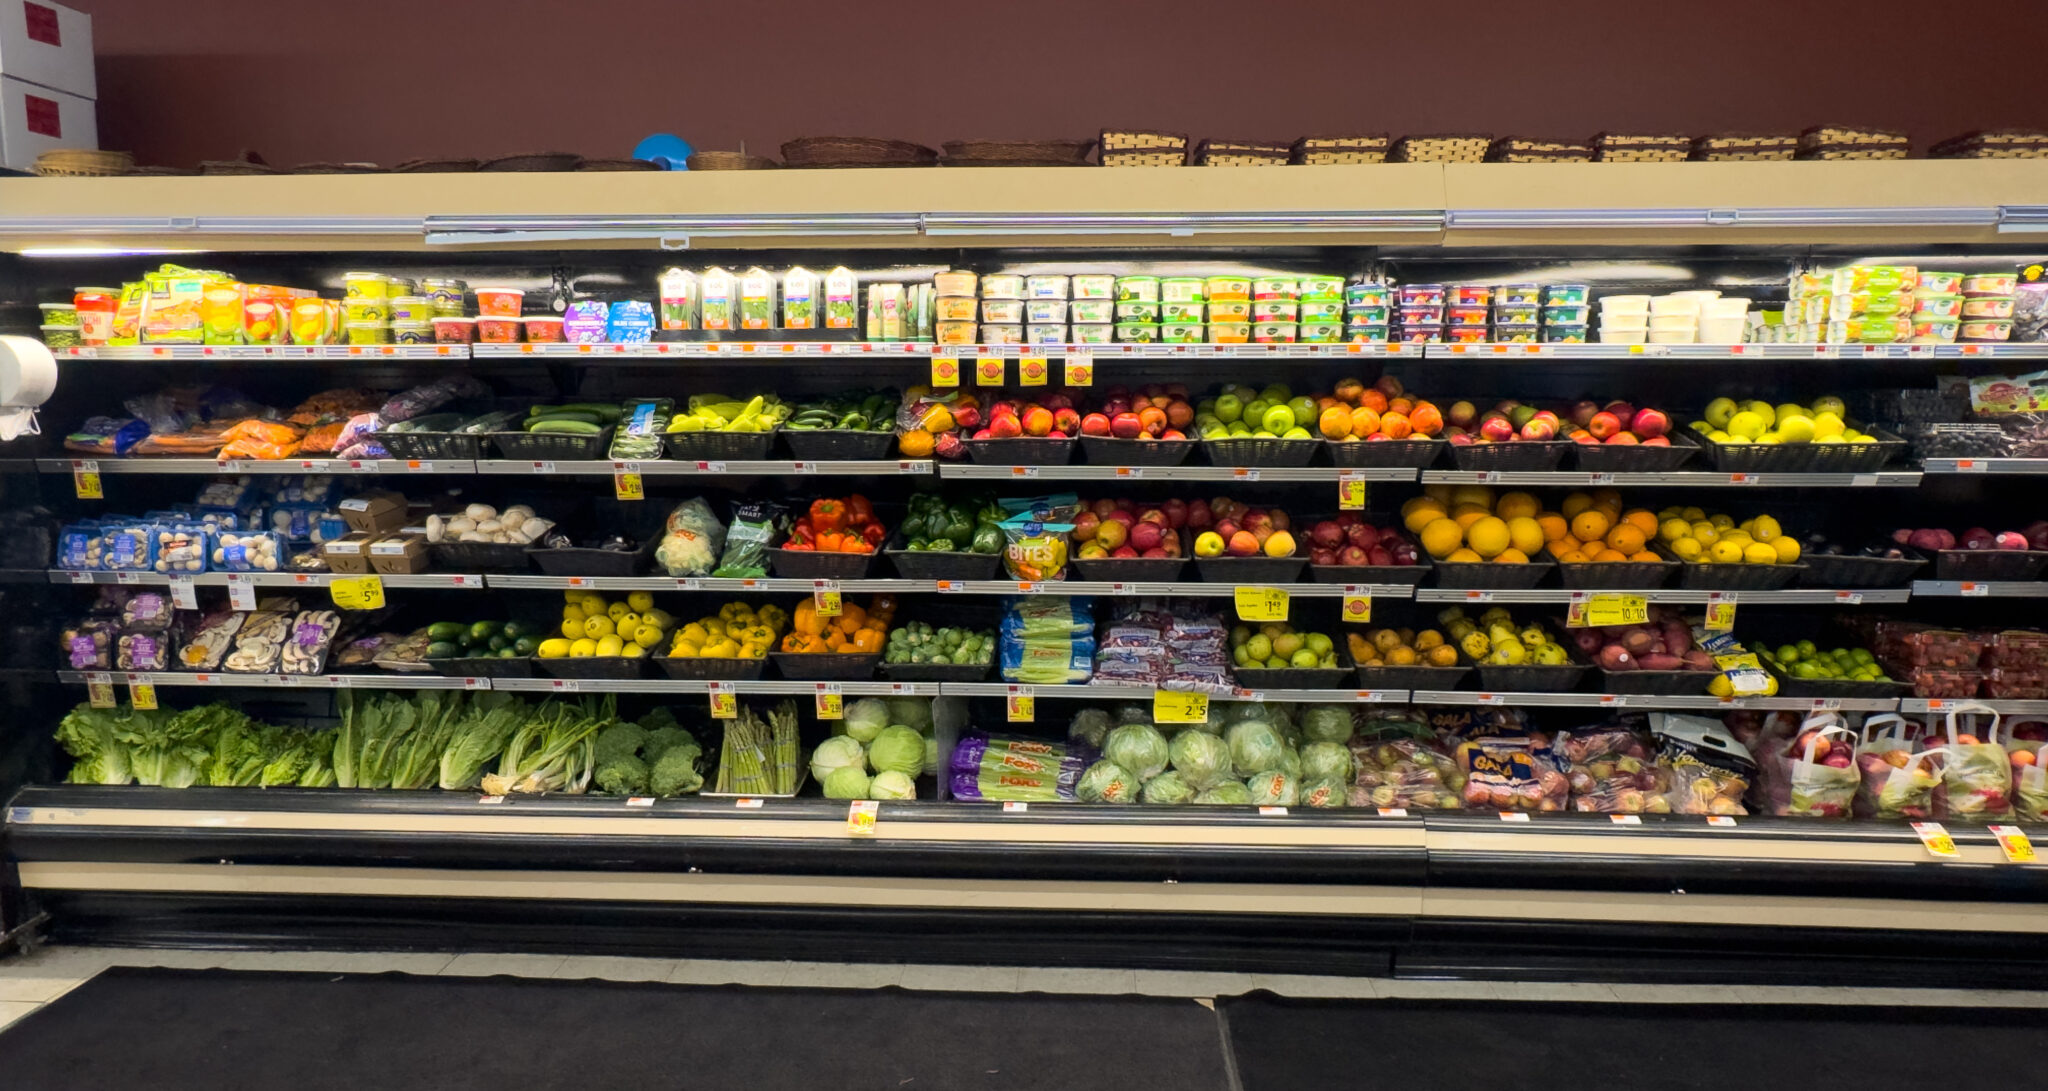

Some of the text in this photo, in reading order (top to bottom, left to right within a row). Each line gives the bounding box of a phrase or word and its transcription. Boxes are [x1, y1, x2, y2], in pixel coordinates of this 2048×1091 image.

[1008, 544, 1053, 561] BITES
[1468, 725, 1500, 736] ALA
[1474, 755, 1512, 776] GALA
